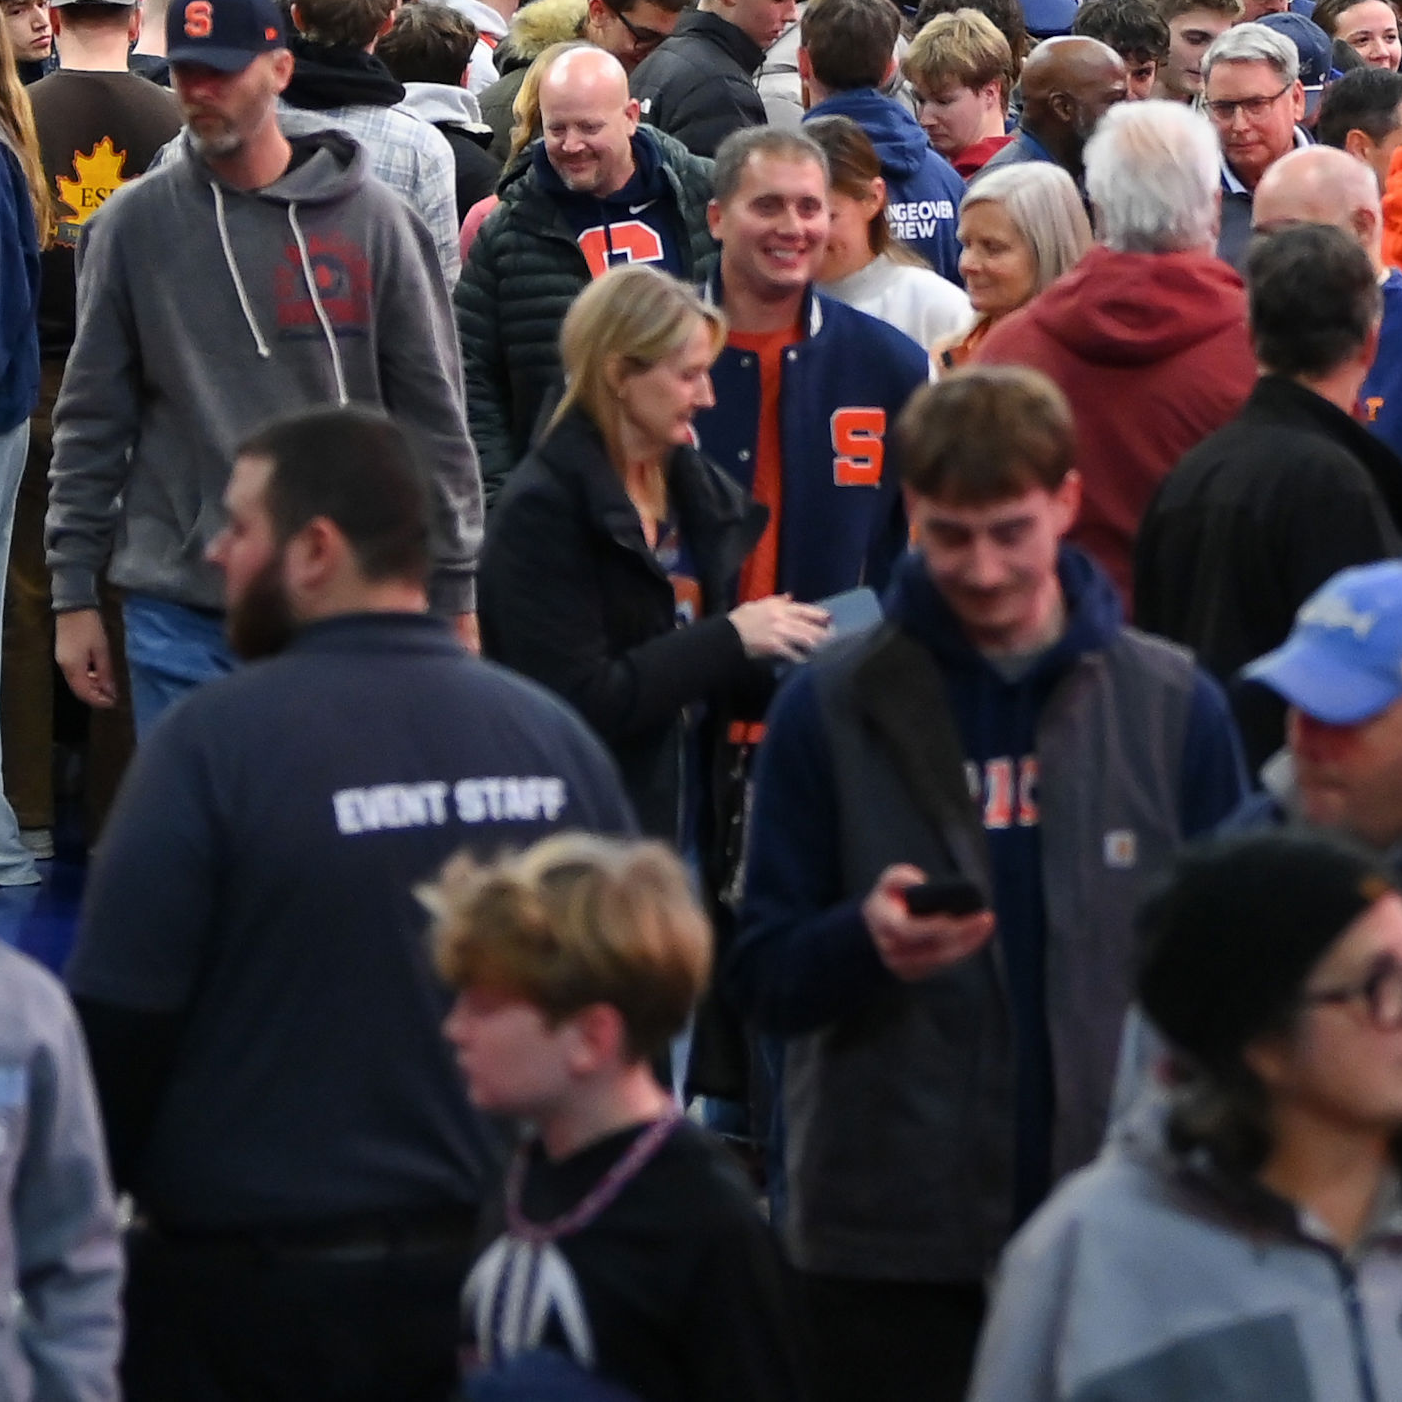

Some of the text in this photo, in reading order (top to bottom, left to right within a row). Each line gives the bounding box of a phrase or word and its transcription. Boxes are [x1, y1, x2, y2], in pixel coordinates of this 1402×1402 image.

[184, 0, 213, 38] S
[884, 200, 955, 222] NGEOVER
[889, 219, 938, 240] CREW
[830, 406, 887, 488] S
[333, 777, 569, 835] EVENT STAFF
